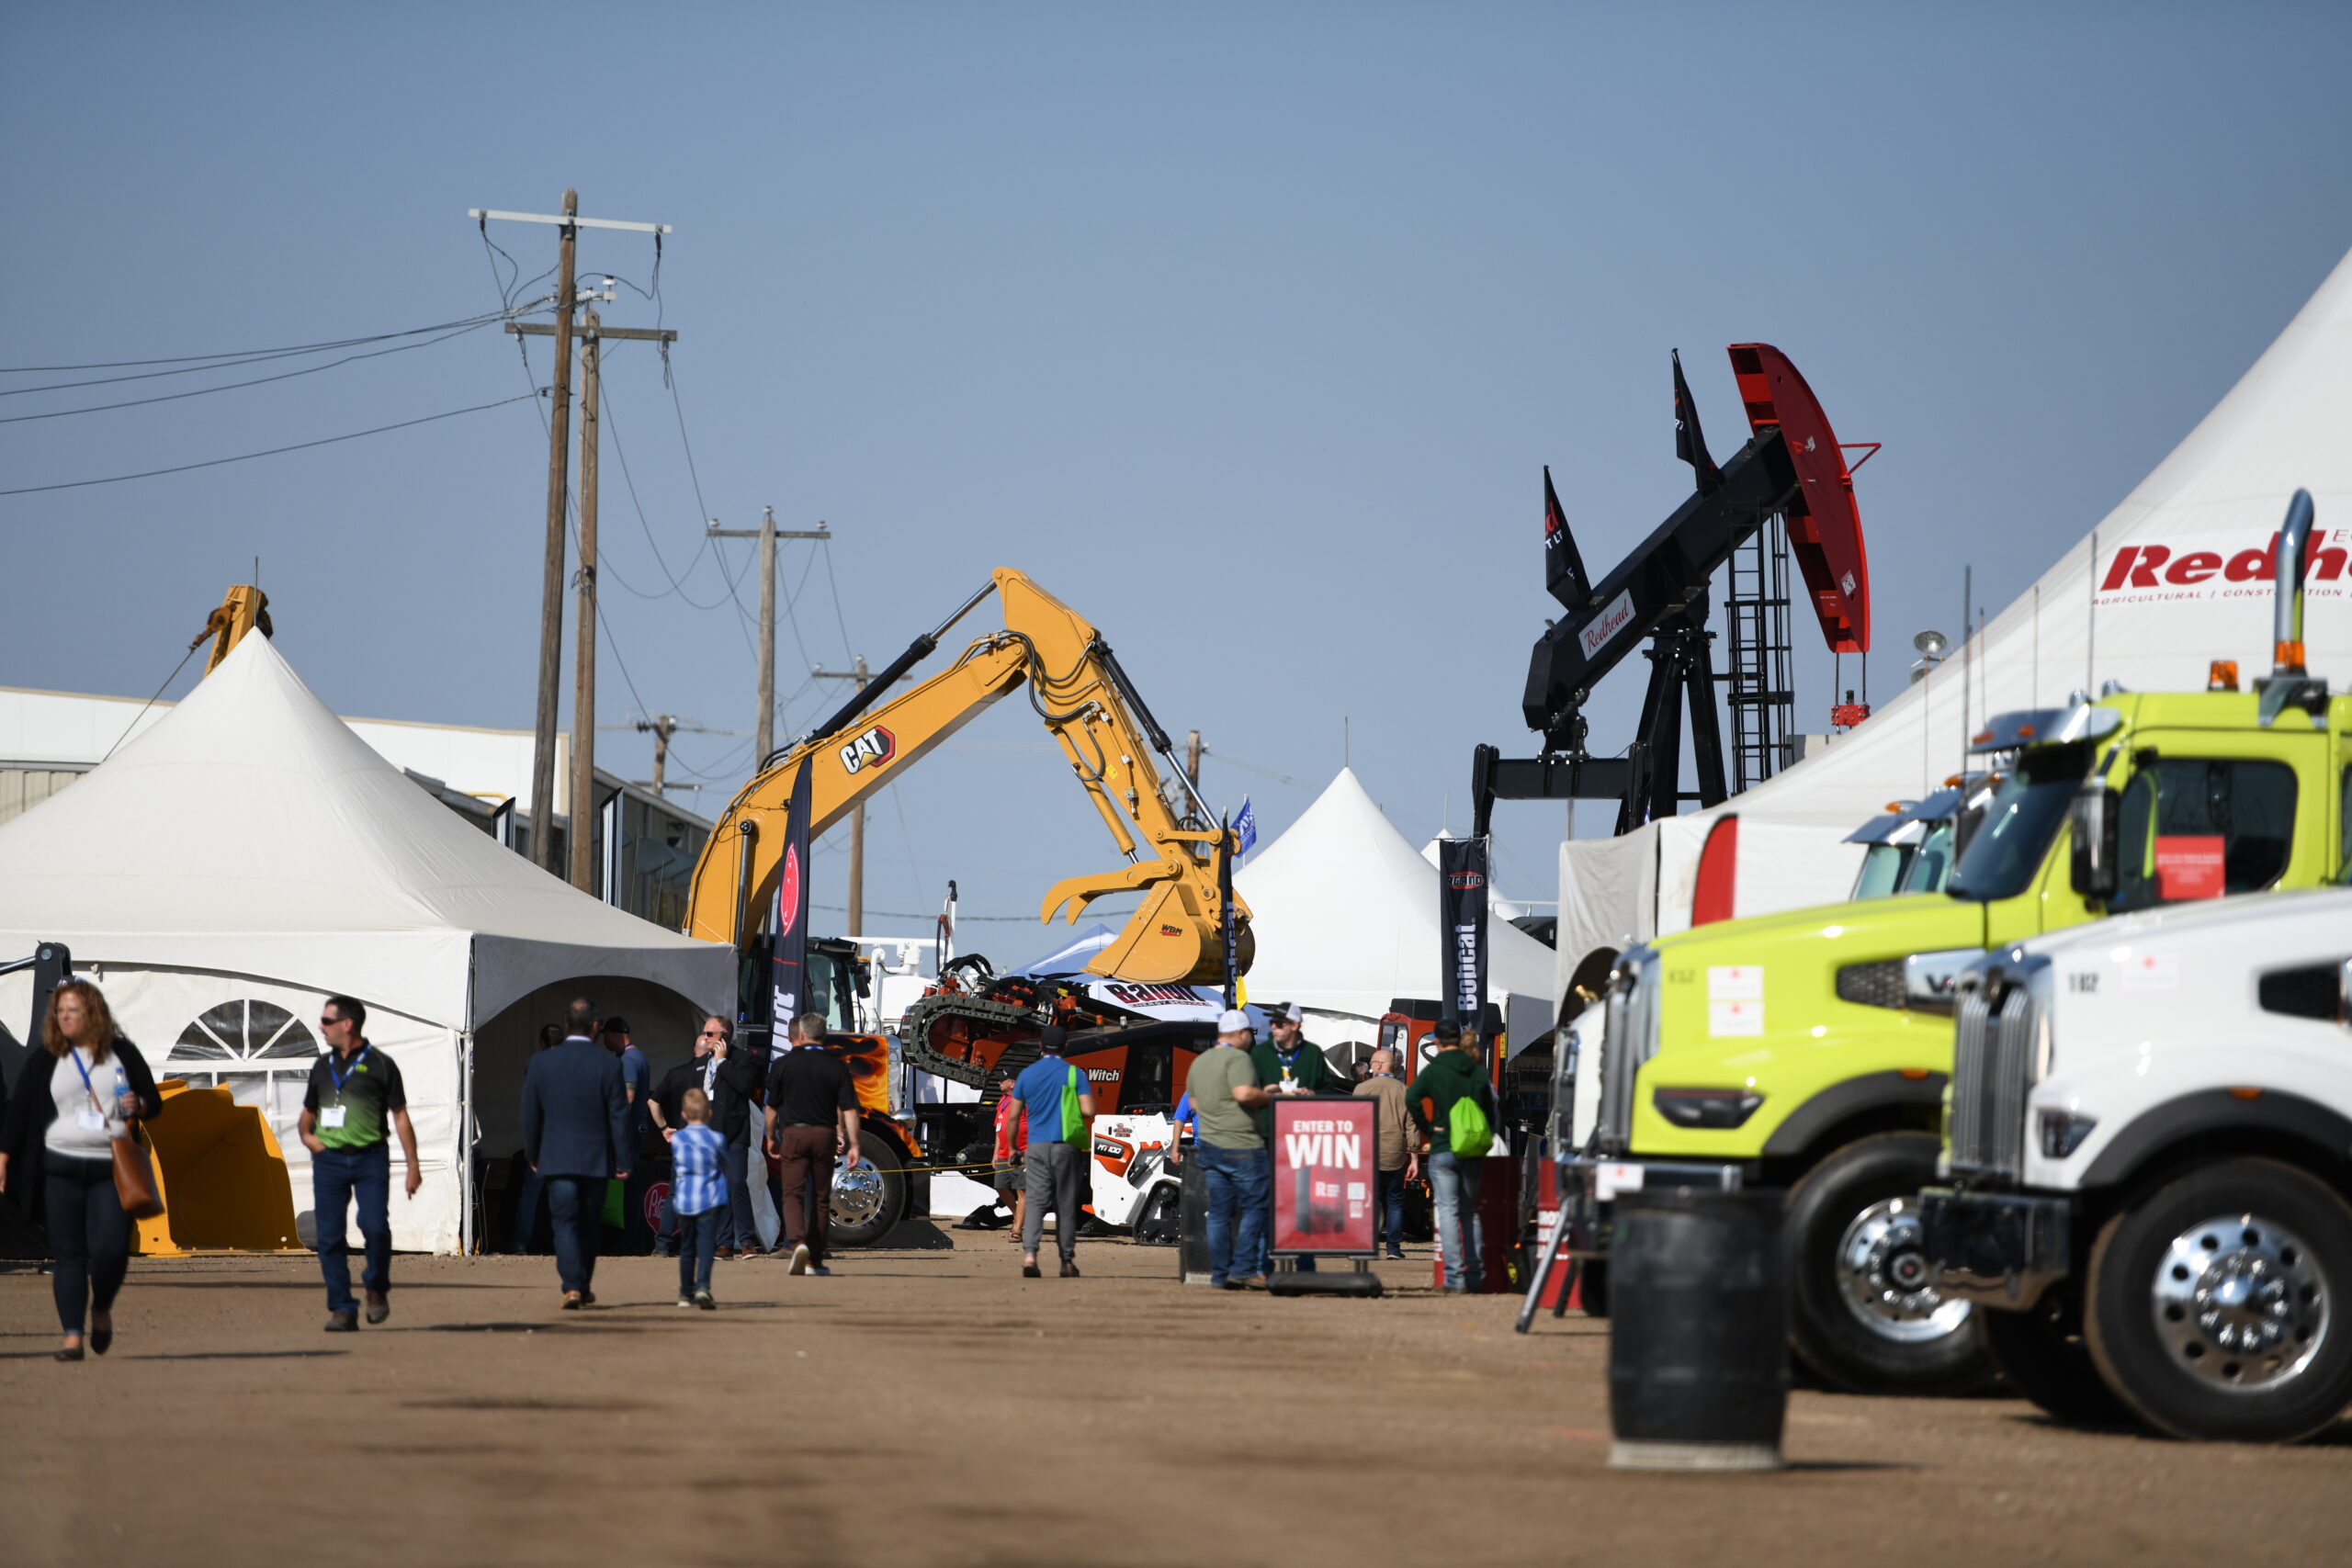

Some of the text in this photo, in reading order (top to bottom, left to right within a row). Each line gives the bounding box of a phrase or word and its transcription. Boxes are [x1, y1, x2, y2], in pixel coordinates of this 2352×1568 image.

[2100, 530, 2352, 591] Redh
[2092, 591, 2202, 605] AGRICULTURAL
[2223, 589, 2343, 597] CONSTTION
[1584, 599, 1629, 652] Redhead
[840, 728, 884, 773] CAT
[1161, 924, 1182, 934] WBM
[1455, 922, 1477, 1011] Bobcat
[1088, 1068, 1120, 1081] Witch
[1293, 1121, 1352, 1133] ENTER TO
[1285, 1134, 1361, 1169] WIN
